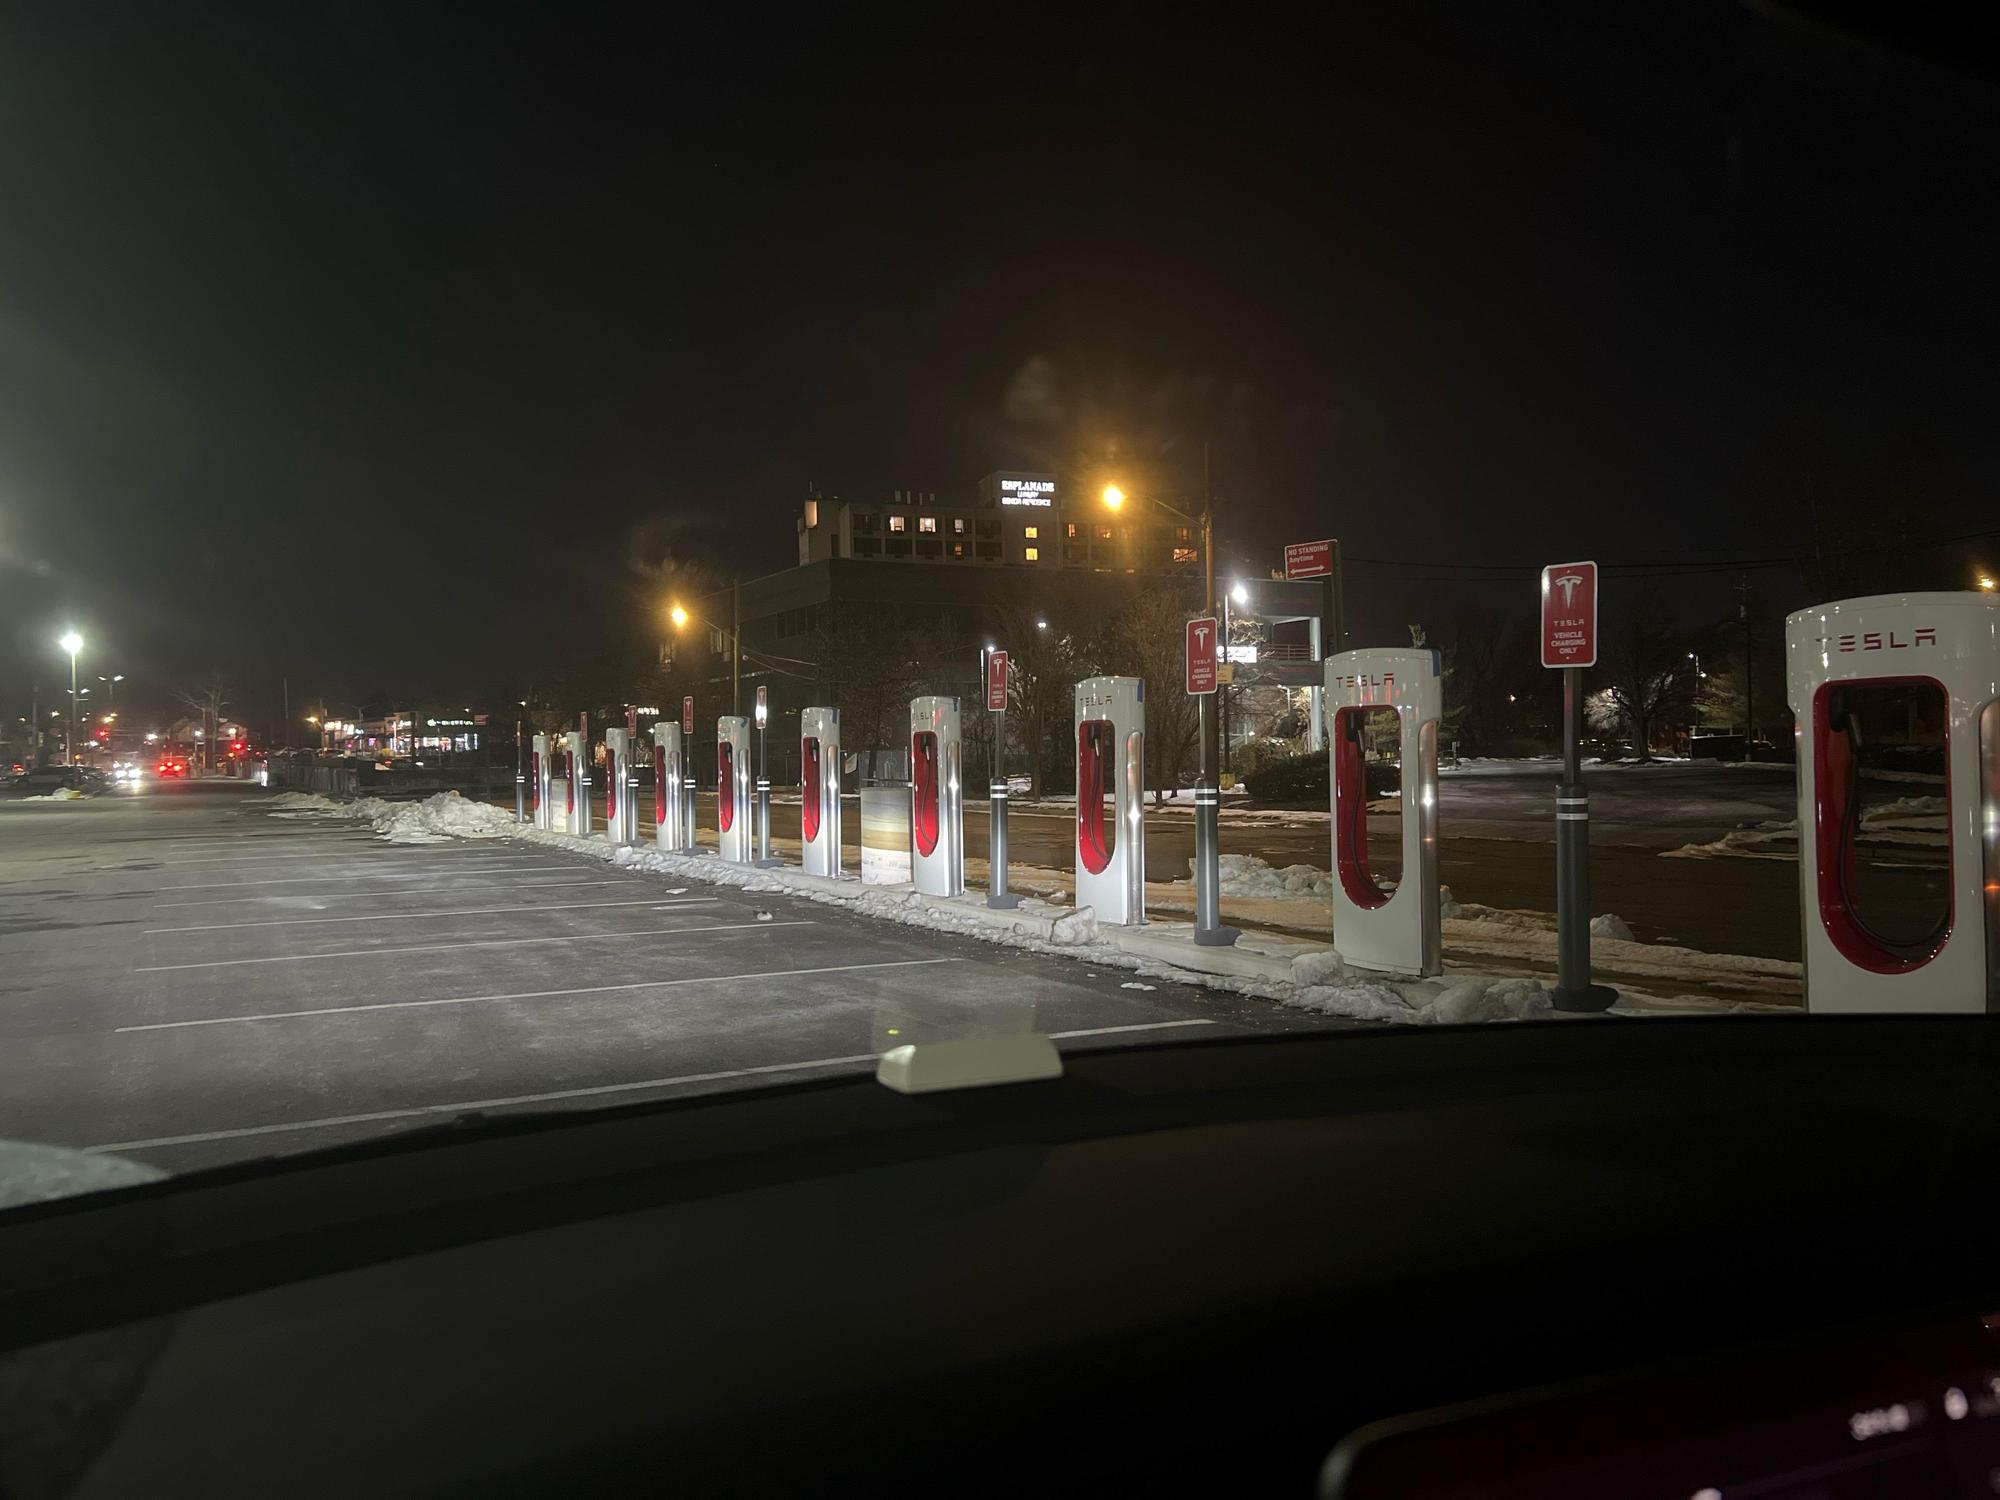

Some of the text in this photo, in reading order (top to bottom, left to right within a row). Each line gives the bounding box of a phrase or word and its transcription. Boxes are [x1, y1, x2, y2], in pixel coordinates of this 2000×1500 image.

[1001, 480, 1055, 492] ESPLANADE
[1298, 543, 1329, 555] STANDING
[1289, 555, 1314, 563] Anytime
[1553, 619, 1585, 627] TESLA
[1554, 631, 1583, 639] VEHICLE
[1551, 639, 1586, 647] CHARGING
[1815, 628, 1936, 653] TESLA
[1336, 673, 1395, 688] TESLA
